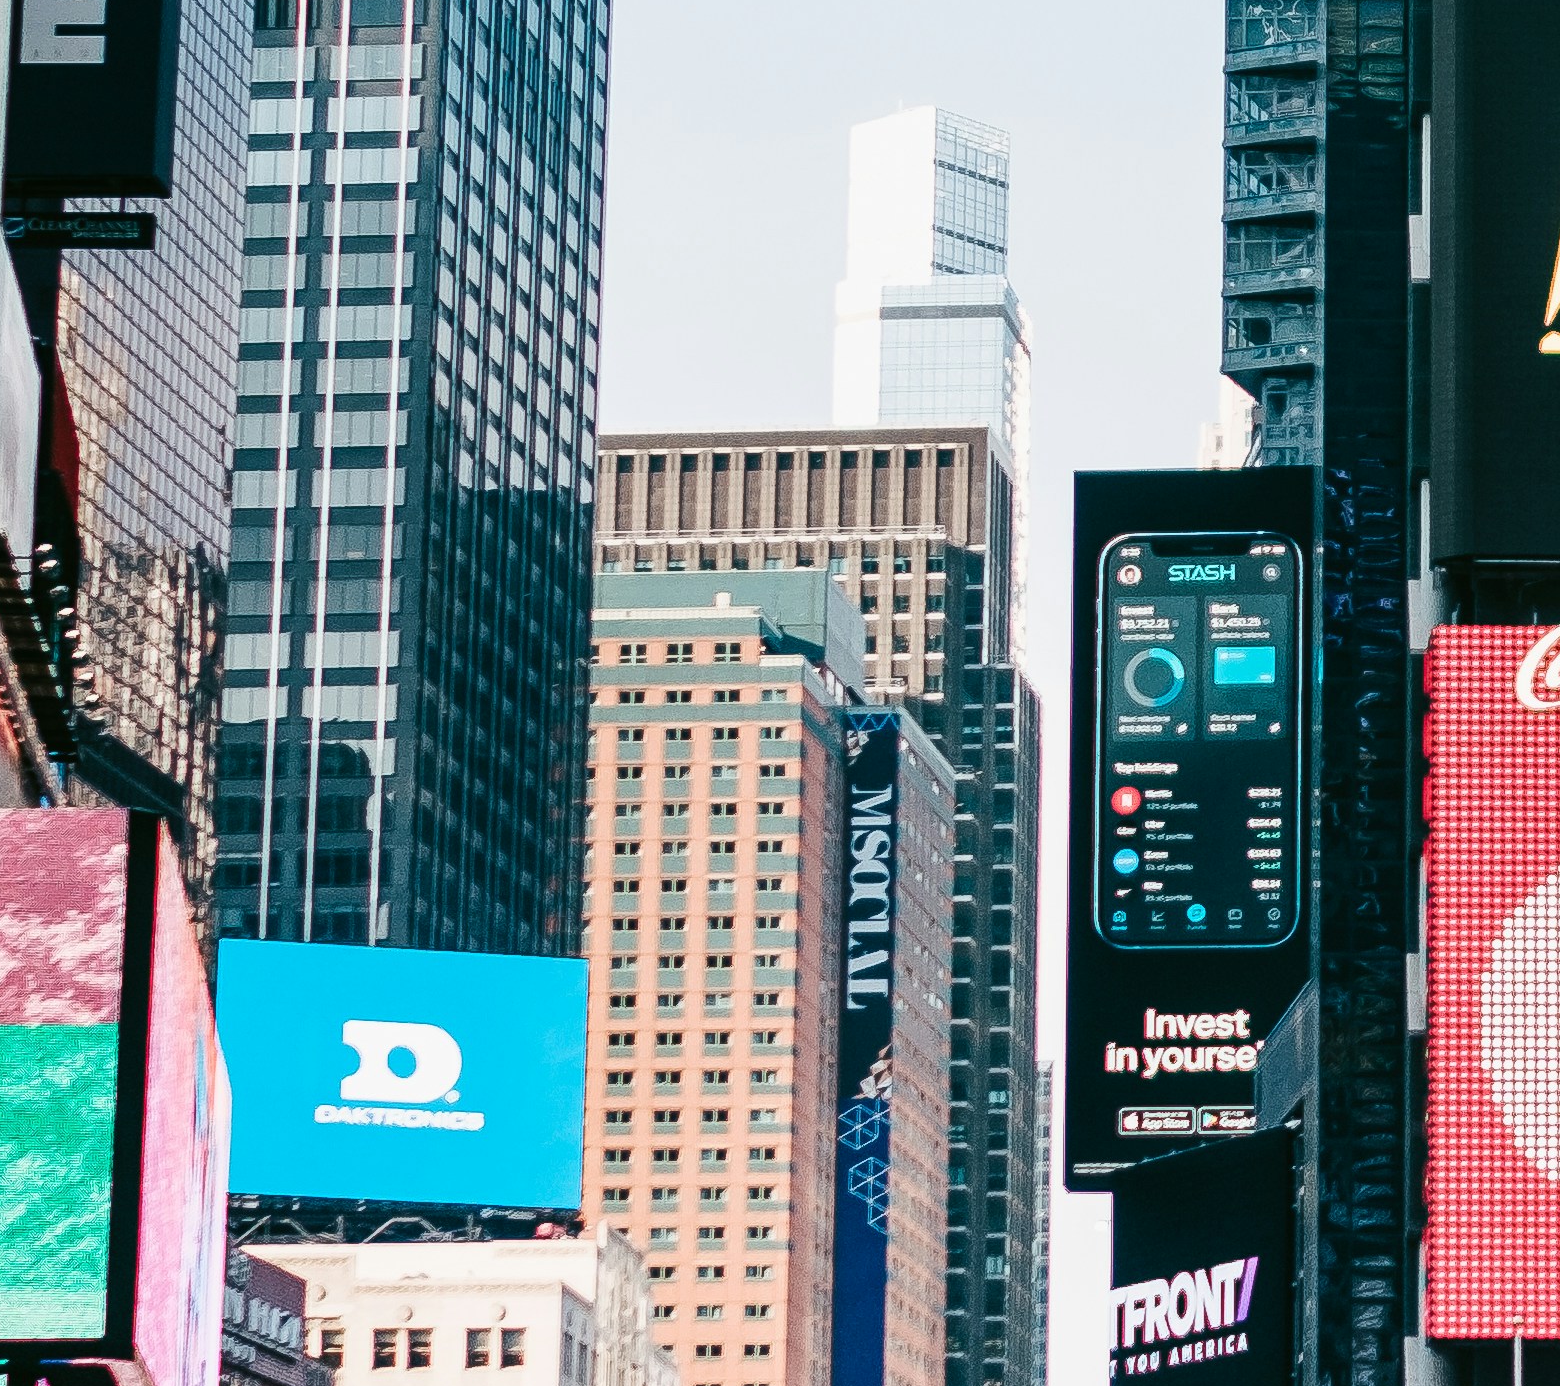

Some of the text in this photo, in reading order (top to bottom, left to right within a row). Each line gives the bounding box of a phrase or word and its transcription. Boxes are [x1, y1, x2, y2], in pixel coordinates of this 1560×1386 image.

[1168, 564, 1236, 582] STASH
[1144, 1007, 1251, 1040] Invest
[1104, 1040, 1266, 1079] in yourse
[313, 1104, 485, 1132] DAKTRONICS
